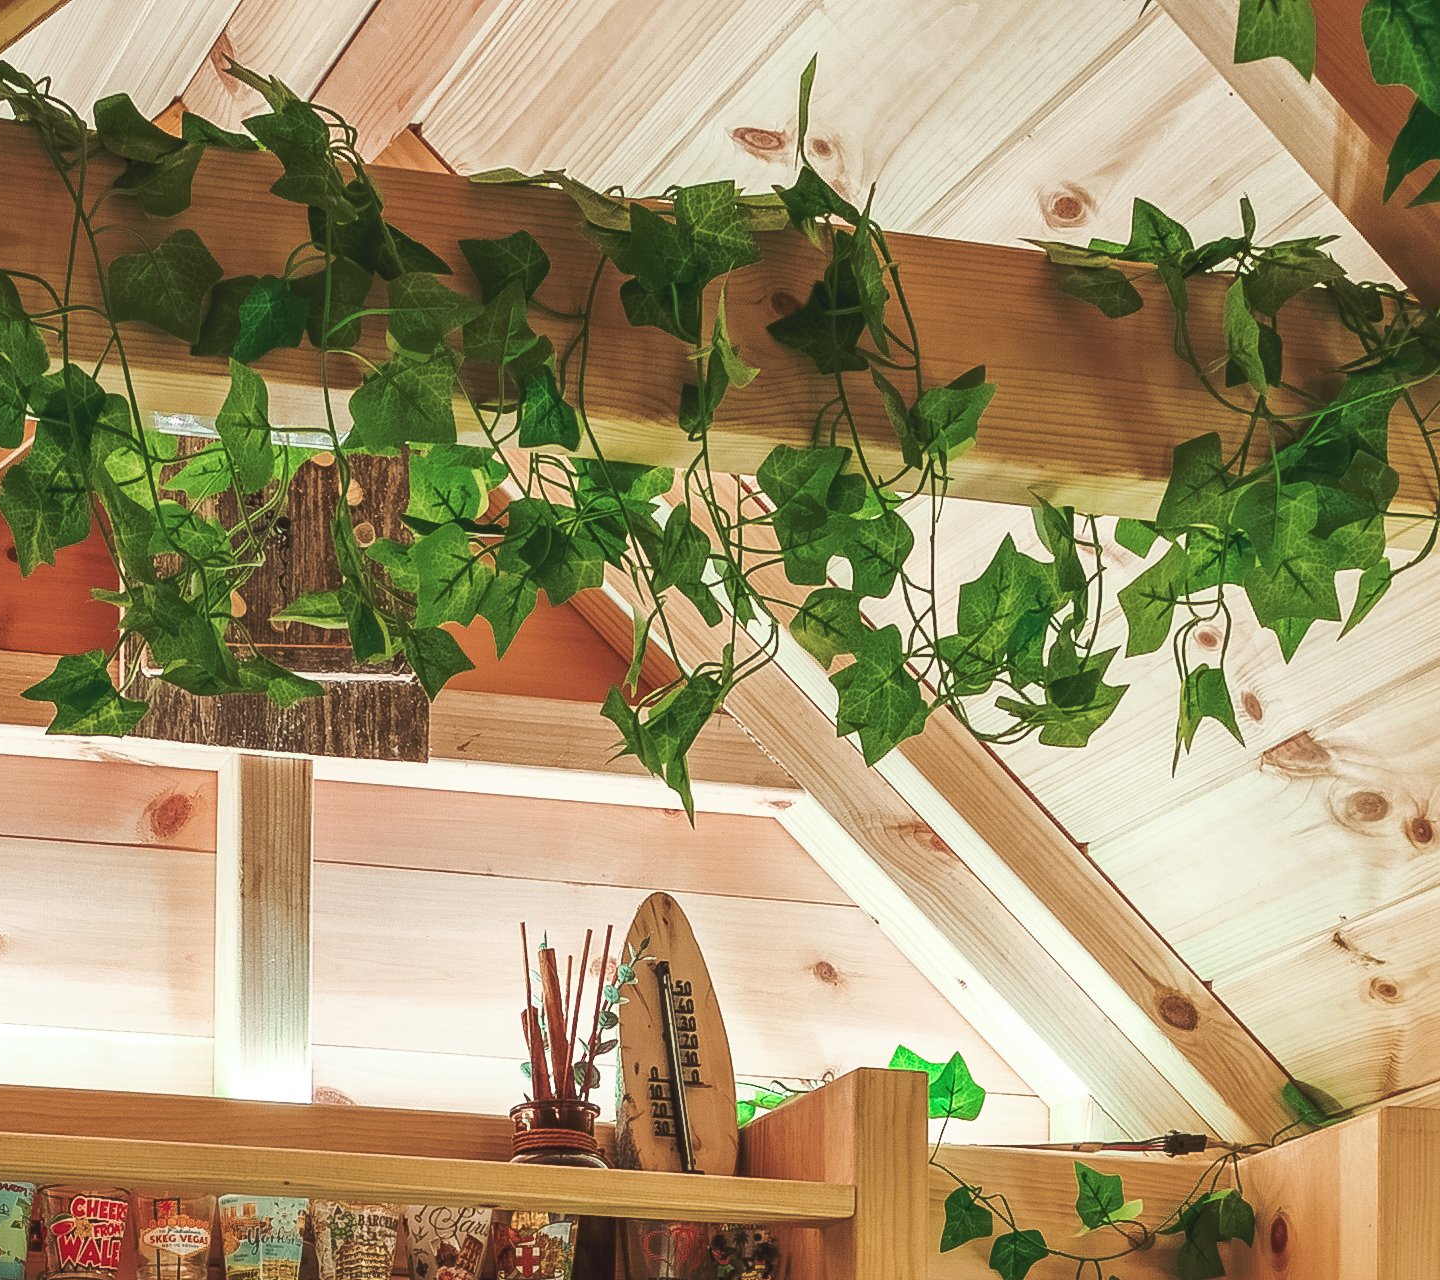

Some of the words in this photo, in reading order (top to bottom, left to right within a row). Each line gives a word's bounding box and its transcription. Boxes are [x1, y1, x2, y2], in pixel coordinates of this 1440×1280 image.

[674, 980, 692, 993] 50
[680, 1016, 696, 1029] 30
[649, 1084, 663, 1097] 10
[149, 1235, 176, 1243] SKEG
[181, 1235, 208, 1244] VEGAS
